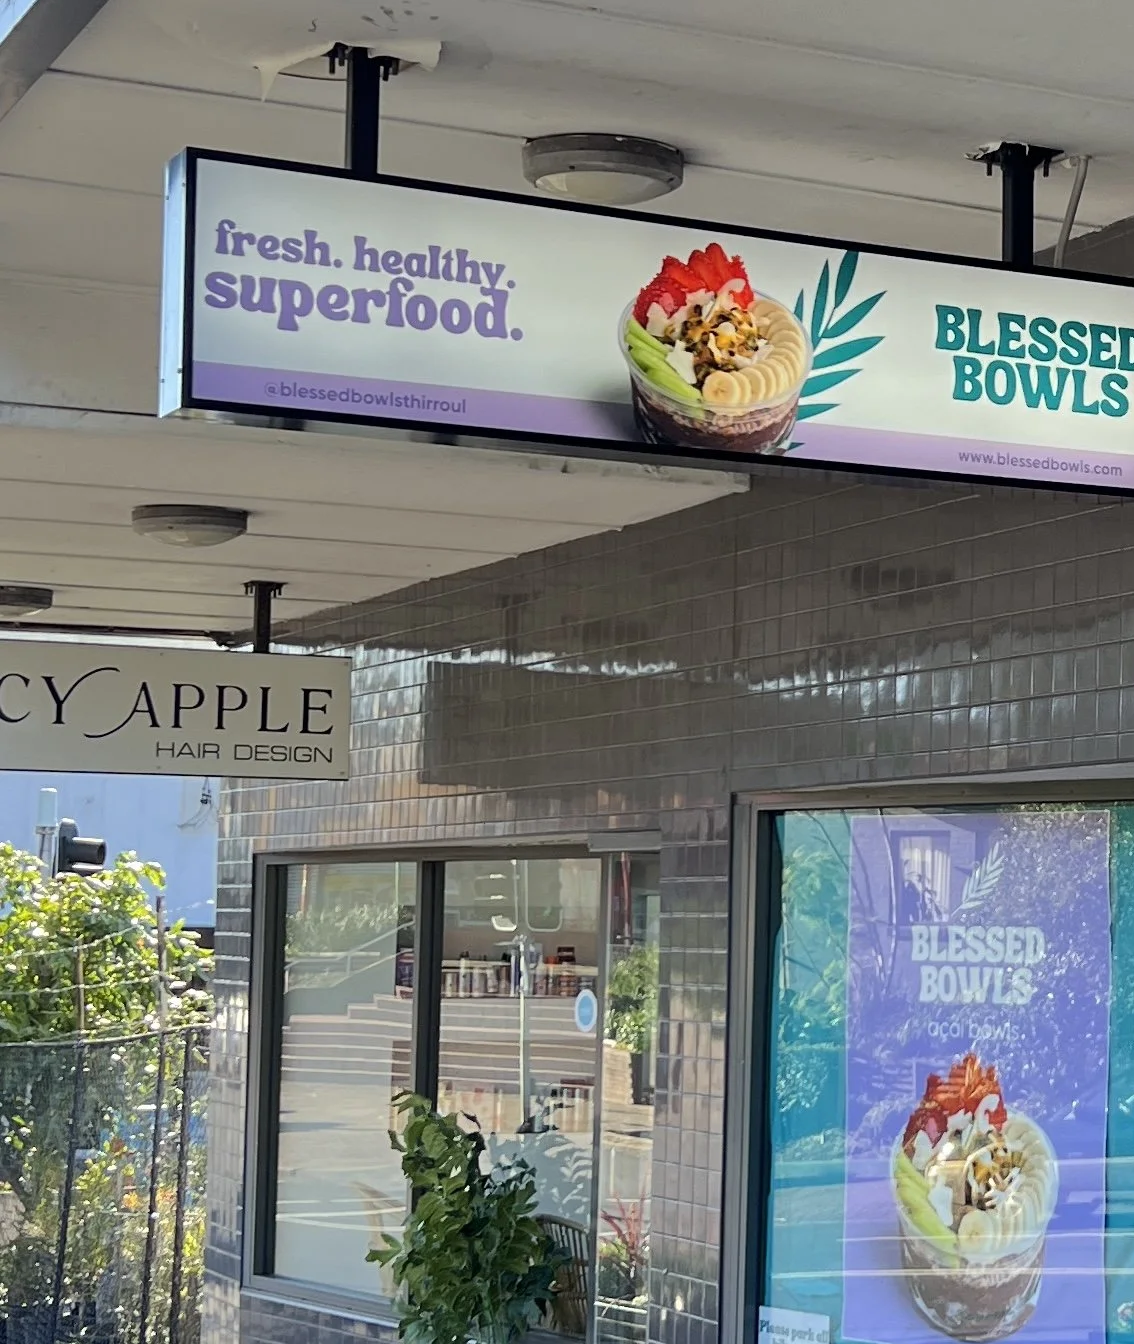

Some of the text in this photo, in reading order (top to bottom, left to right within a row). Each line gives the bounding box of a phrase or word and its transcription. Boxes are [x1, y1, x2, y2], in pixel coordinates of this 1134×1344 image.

[215, 218, 516, 293] fresh. healthy.
[204, 270, 524, 341] superfood.
[263, 380, 467, 415] @blessedbowlsthirroul
[952, 355, 1129, 417] BOWLS
[957, 449, 1124, 478] www.blessedbowls.com
[84, 681, 334, 738] APPLE
[156, 740, 334, 764] HAIR DESIGN
[911, 924, 1046, 964] BLESSED
[919, 964, 1034, 1006] BOWLS
[760, 1319, 790, 1337] Please
